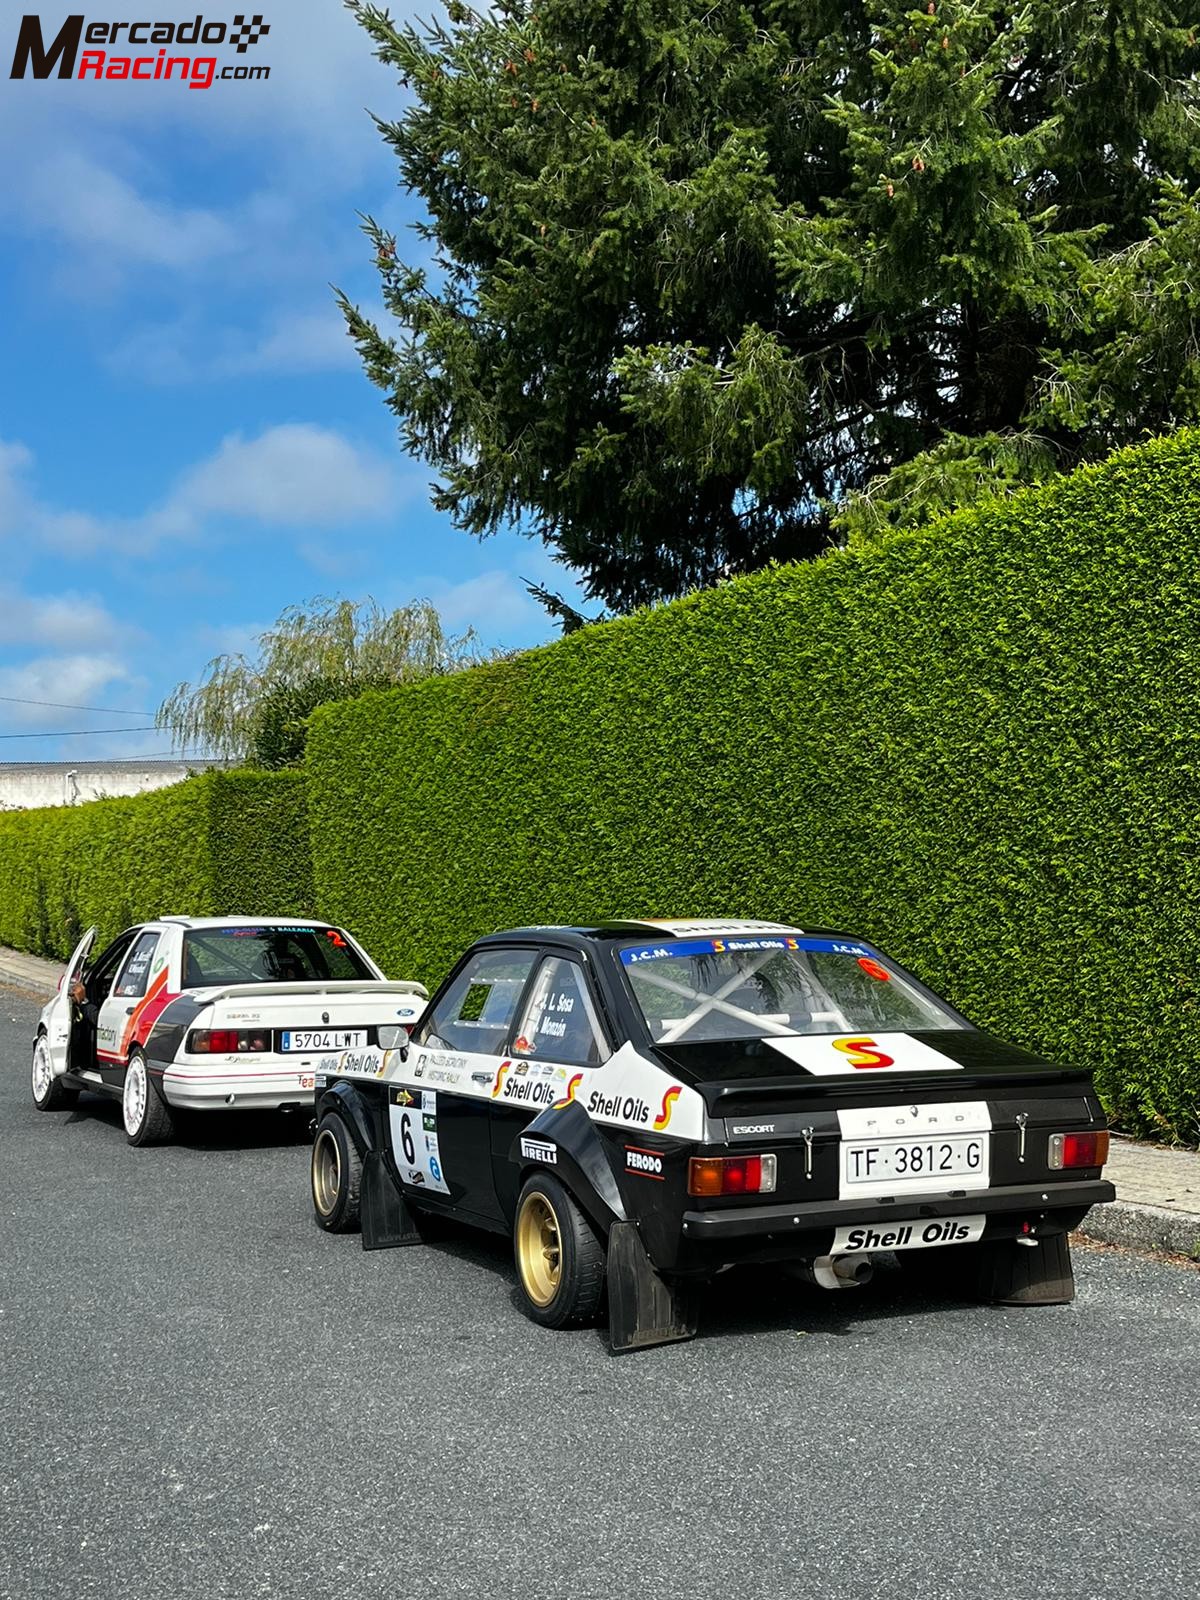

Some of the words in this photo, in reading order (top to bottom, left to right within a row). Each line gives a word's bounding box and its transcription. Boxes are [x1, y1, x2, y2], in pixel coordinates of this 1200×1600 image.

[326, 930, 347, 948] 2
[728, 941, 760, 951] Shell
[761, 940, 785, 950] Oils
[630, 948, 673, 962] J.C.M.
[832, 944, 869, 956] J.C.M.
[557, 993, 574, 1012] Sosa
[295, 1033, 330, 1048] 5704
[335, 1032, 361, 1047] LWT
[344, 1053, 364, 1072] Shell
[364, 1055, 380, 1073] Oils
[504, 1078, 531, 1101] Shell
[532, 1082, 554, 1104] Oils
[587, 1091, 622, 1118] Shell
[622, 1098, 650, 1123] Oils
[733, 1124, 775, 1134] ESCORT
[400, 1113, 415, 1165] 6
[520, 1137, 557, 1165] PIRELLI
[626, 1151, 662, 1173] FERODO
[844, 1226, 913, 1250] Shell
[922, 1221, 970, 1243] Oils
